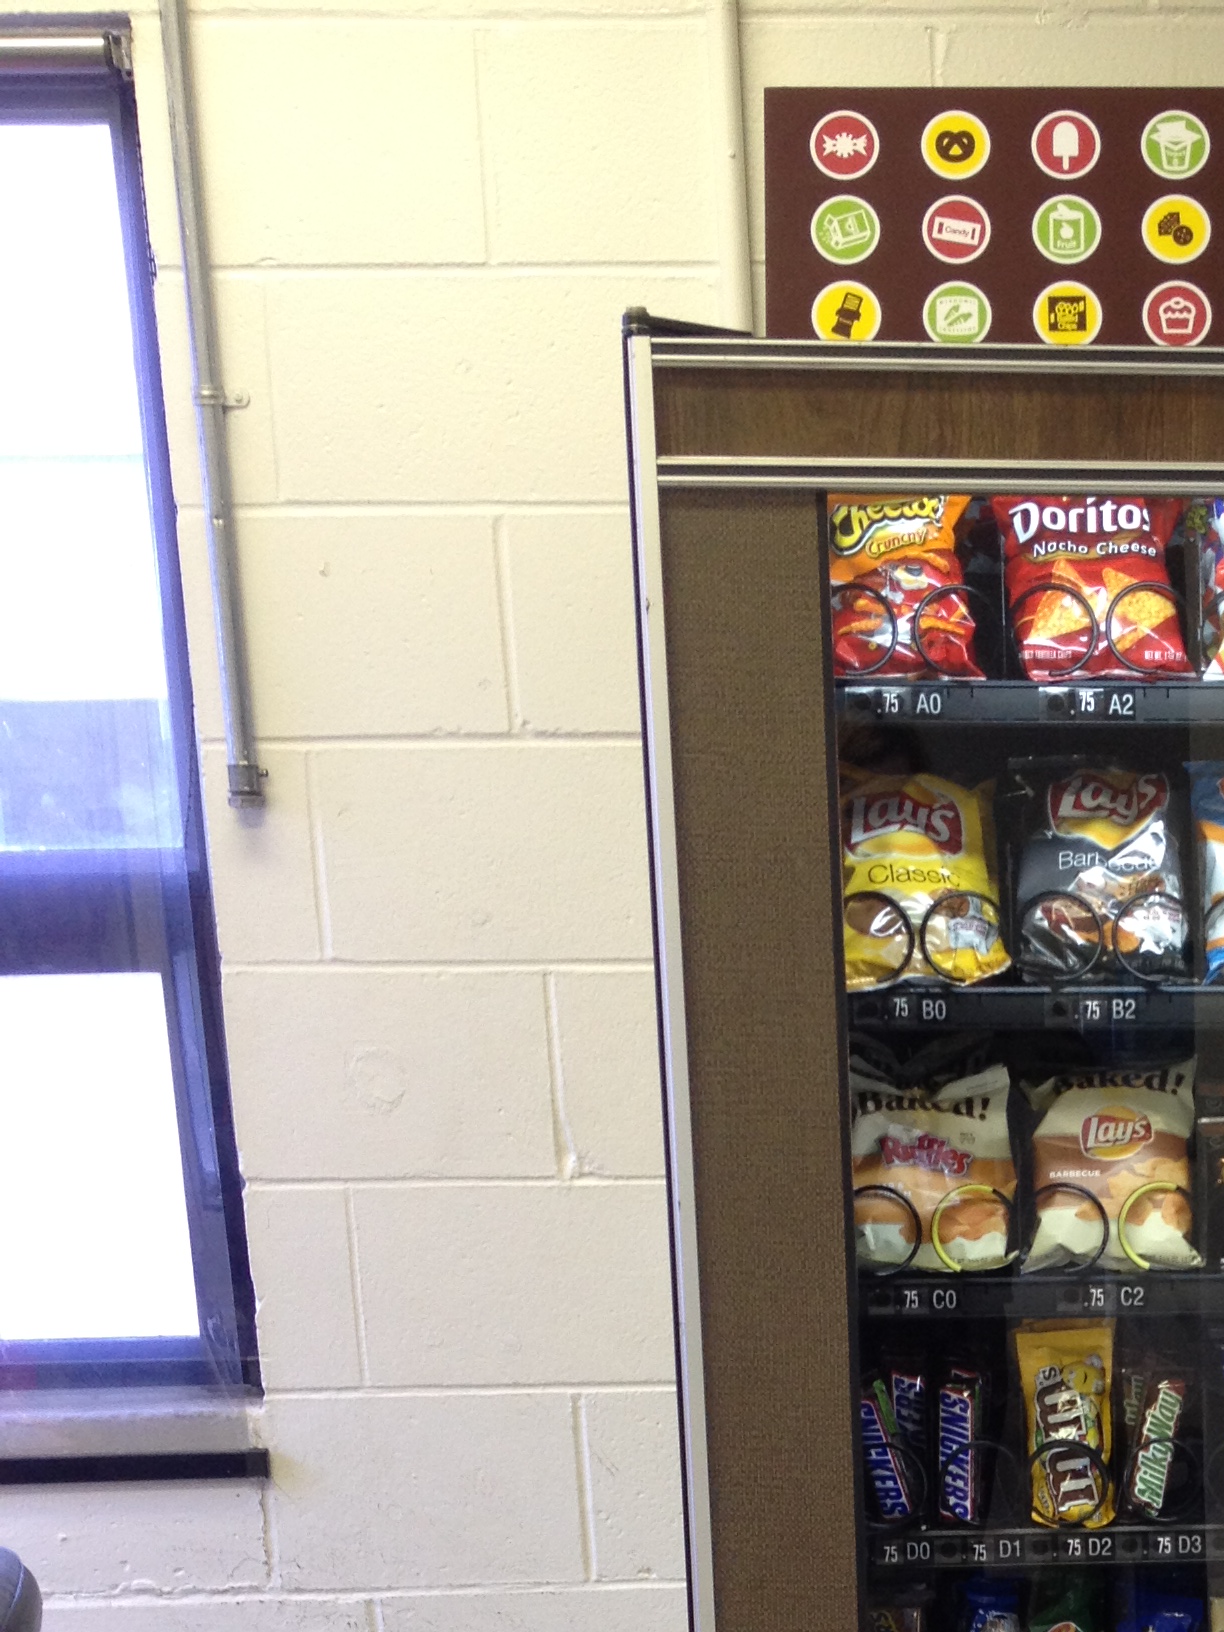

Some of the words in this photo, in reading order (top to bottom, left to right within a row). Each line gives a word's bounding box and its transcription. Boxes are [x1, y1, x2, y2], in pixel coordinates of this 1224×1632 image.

[944, 225, 971, 238] Candy
[1056, 240, 1078, 250] Fruit
[1009, 497, 1149, 543] Doritos
[867, 527, 926, 557] Crunchy
[1033, 540, 1088, 557] Nacho
[1096, 541, 1157, 557] Cheese
[916, 692, 942, 715] A0
[1108, 693, 1134, 716] A2
[1059, 775, 1162, 823] Lay's
[851, 791, 955, 844] Lay's
[868, 863, 960, 887] Classic
[922, 1000, 947, 1020] B0
[1112, 999, 1136, 1020] B2
[1088, 1115, 1147, 1148] Lay's
[1049, 1169, 1101, 1179] BARBECUE
[932, 1289, 957, 1310] C0
[1120, 1286, 1145, 1307] C2
[1136, 1441, 1174, 1509] Milky
[907, 1542, 930, 1560] D0
[999, 1540, 1021, 1558] D1
[1088, 1537, 1112, 1556] D2
[1179, 1535, 1202, 1553] D3
